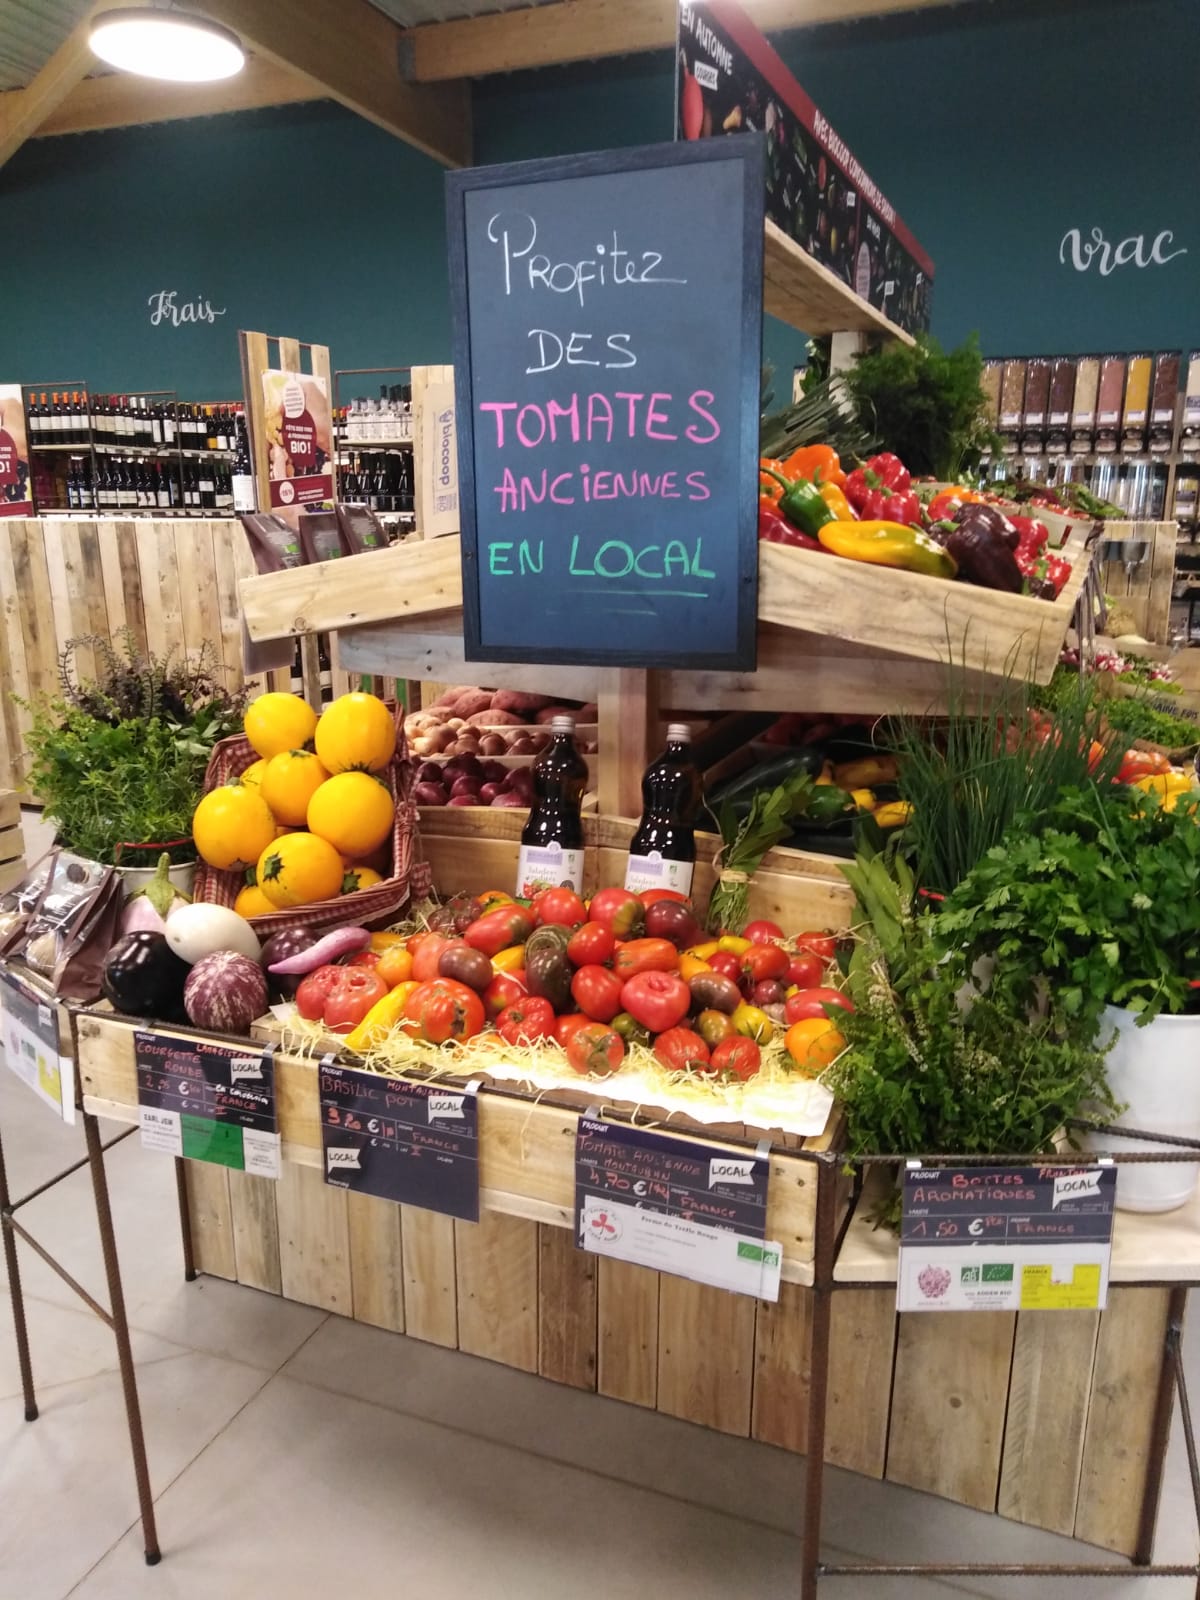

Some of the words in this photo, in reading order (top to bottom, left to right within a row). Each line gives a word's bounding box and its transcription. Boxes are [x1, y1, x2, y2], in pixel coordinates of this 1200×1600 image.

[681, 6, 695, 34] EN
[696, 17, 733, 76] AUTOMNE
[148, 290, 227, 327] Frais
[526, 329, 637, 374] DES
[479, 390, 721, 448] TOMATES
[439, 423, 453, 486] biocoop
[494, 464, 711, 513] ANCIENNES
[488, 540, 544, 576] EN
[569, 535, 716, 579] LOCAL
[231, 1063, 259, 1072] LOCAL
[321, 1067, 344, 1076] PRODUIT
[178, 1081, 190, 1095] €
[321, 1075, 380, 1100] BASILIC
[215, 1093, 257, 1110] FRANCE
[430, 1102, 460, 1112] LOCAL
[367, 1118, 380, 1133] €
[582, 1121, 610, 1132] PRODUIT
[412, 1132, 460, 1151] FRANCE
[329, 1153, 356, 1161] LOCAL
[711, 1165, 748, 1178] LOCAL
[910, 1171, 941, 1180] PRODUIT
[633, 1180, 647, 1196] €
[912, 1186, 1036, 1203] AROMATIQUES
[1056, 1179, 1096, 1194] LOCAL
[680, 1196, 737, 1218] FRANCE
[967, 1218, 984, 1236] €
[1016, 1223, 1074, 1234] FRANCE
